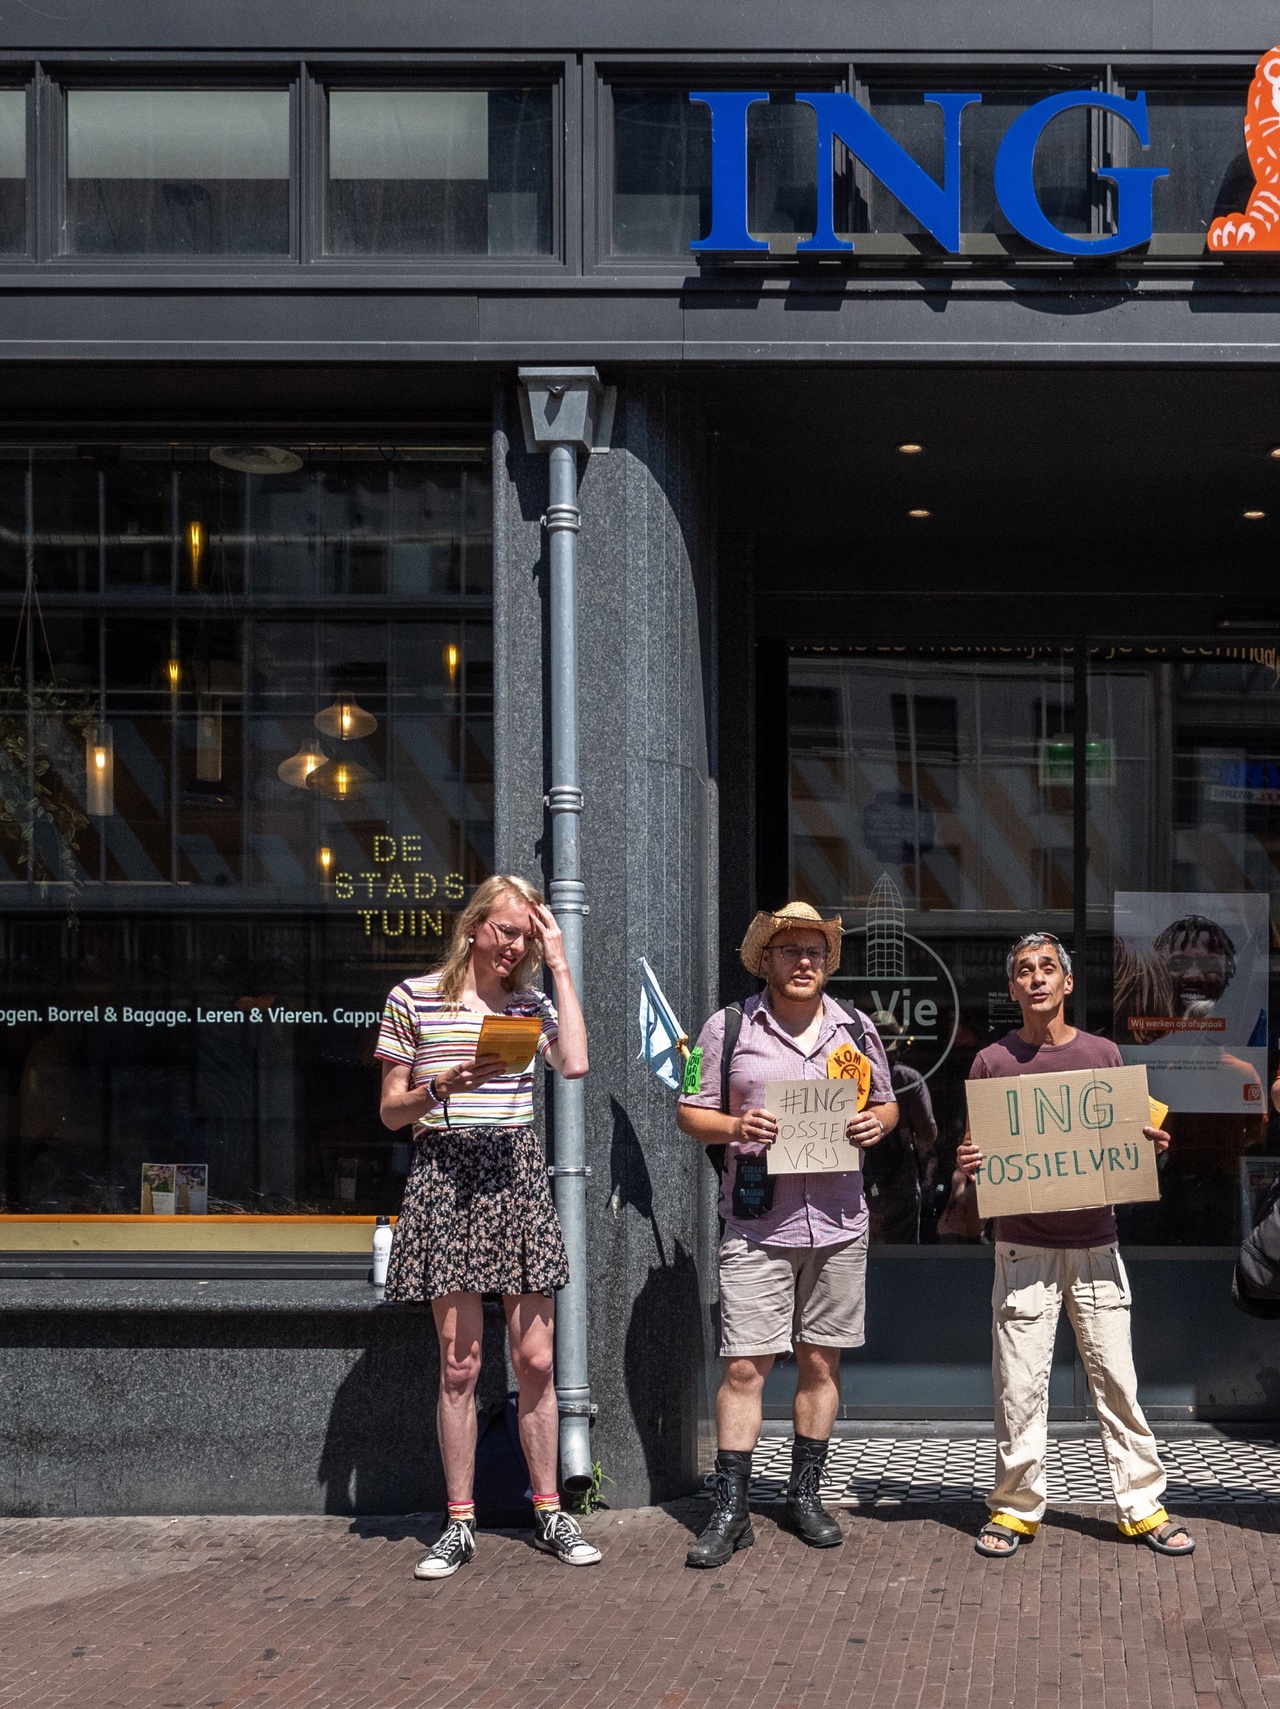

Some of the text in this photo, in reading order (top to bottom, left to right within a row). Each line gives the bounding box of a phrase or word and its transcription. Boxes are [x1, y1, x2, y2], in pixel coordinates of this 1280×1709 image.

[688, 90, 1170, 255] ING
[373, 835, 422, 862] DE
[336, 872, 464, 900] STADS
[357, 910, 444, 937] TUIN
[48, 1006, 99, 1022] Borrel
[104, 1007, 118, 1022] &
[123, 1007, 192, 1027] Bagage.
[197, 1007, 244, 1023] Leren
[249, 1007, 263, 1023] &
[268, 1007, 328, 1023] Vieren.
[870, 988, 938, 1026] Vie
[1131, 1019, 1223, 1030] Wij werken op afspraak
[833, 1050, 862, 1068] KOM
[780, 1087, 853, 1114] #ING
[1006, 1080, 1114, 1136] ING
[777, 1118, 850, 1143] OSSIEL
